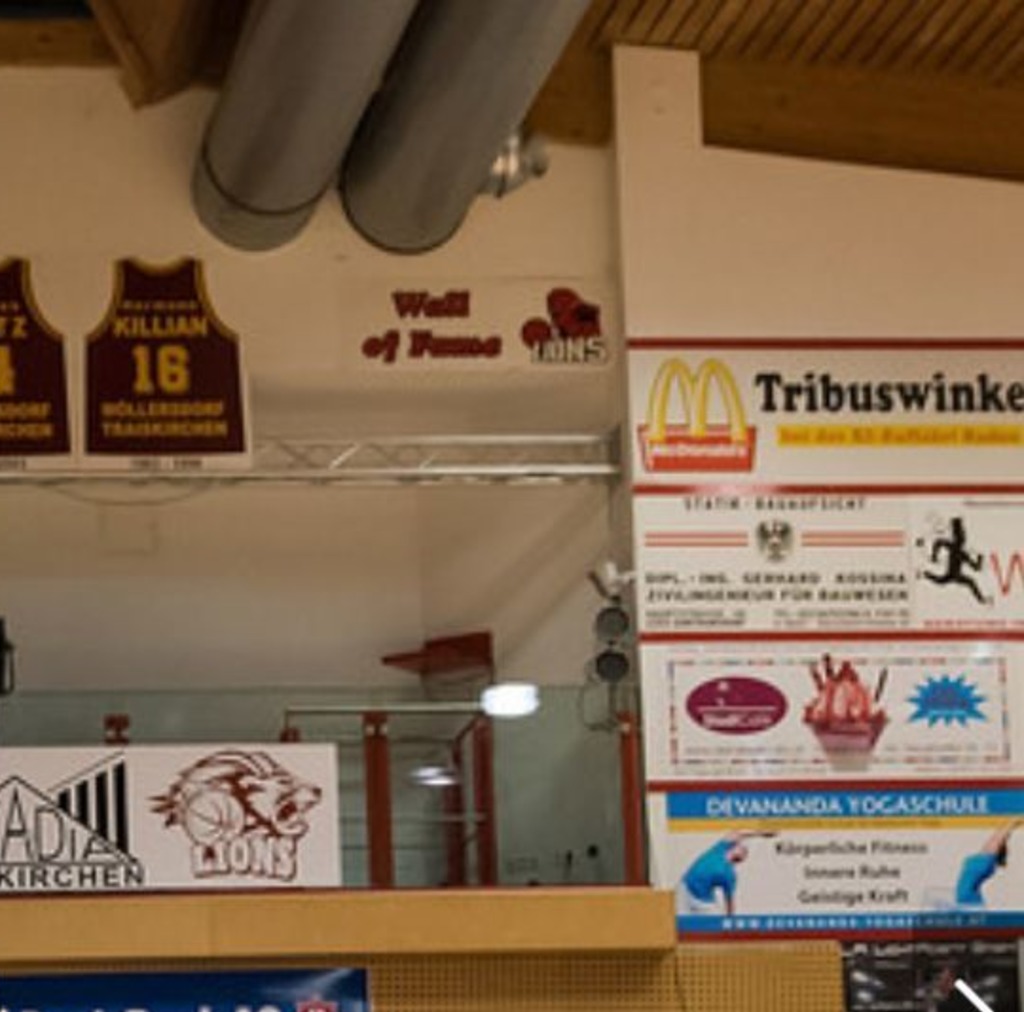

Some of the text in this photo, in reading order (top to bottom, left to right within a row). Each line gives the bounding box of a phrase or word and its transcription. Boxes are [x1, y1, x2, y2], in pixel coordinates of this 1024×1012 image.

[132, 345, 190, 394] 16
[706, 796, 988, 815] DEVANANDA YOGASCHULE
[191, 838, 298, 882] LIONS
[860, 866, 900, 879] Ruhe
[869, 889, 908, 903] Kraft
